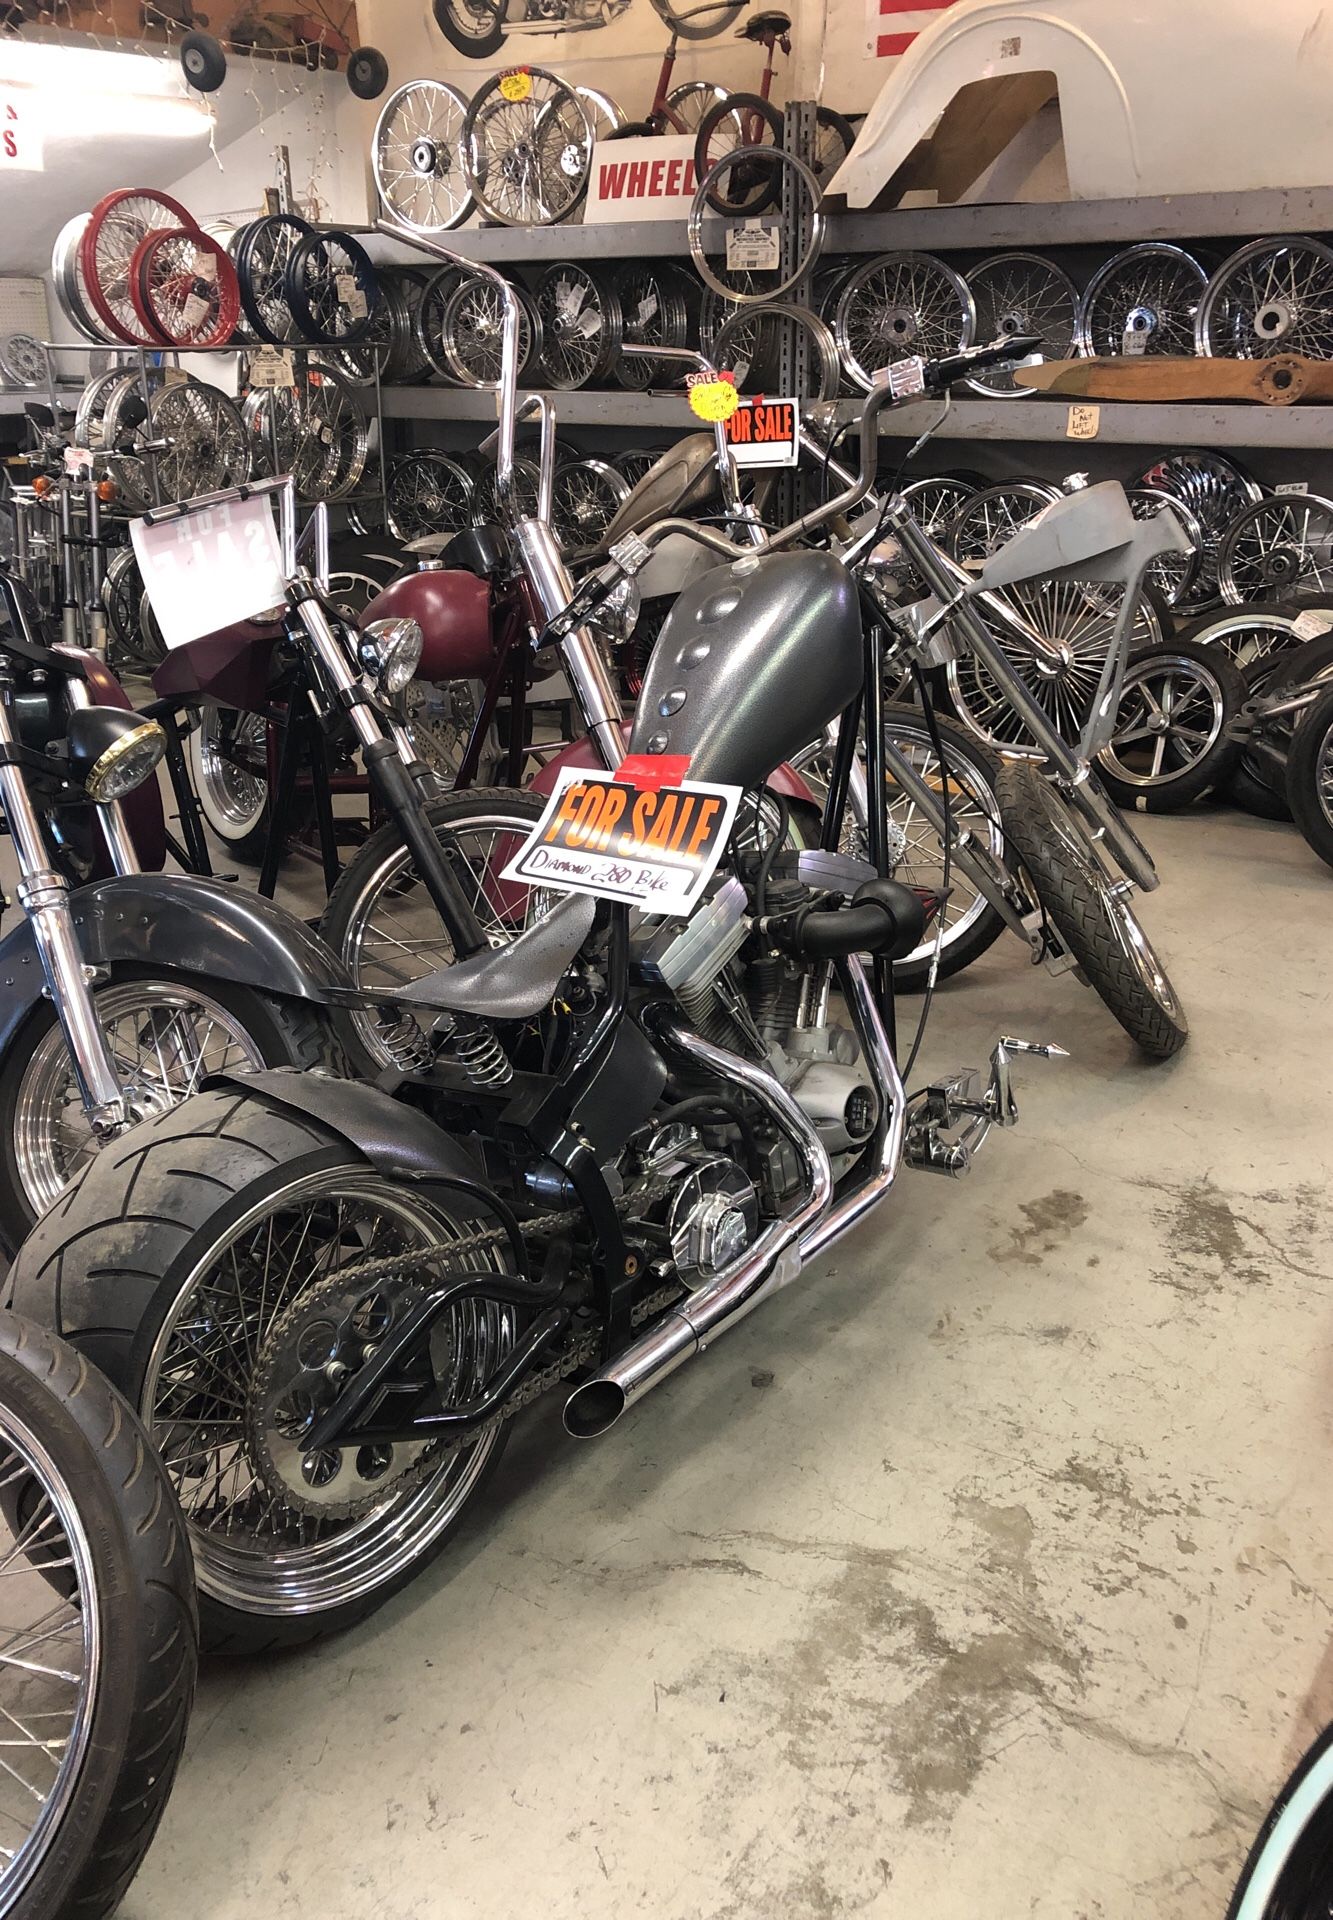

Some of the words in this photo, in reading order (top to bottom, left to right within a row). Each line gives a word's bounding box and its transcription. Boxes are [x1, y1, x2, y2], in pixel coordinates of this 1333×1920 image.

[687, 373, 718, 387] SALE
[755, 405, 792, 441] SALE
[544, 784, 627, 853] FOR
[617, 790, 721, 865] SALE
[590, 862, 633, 884] 280
